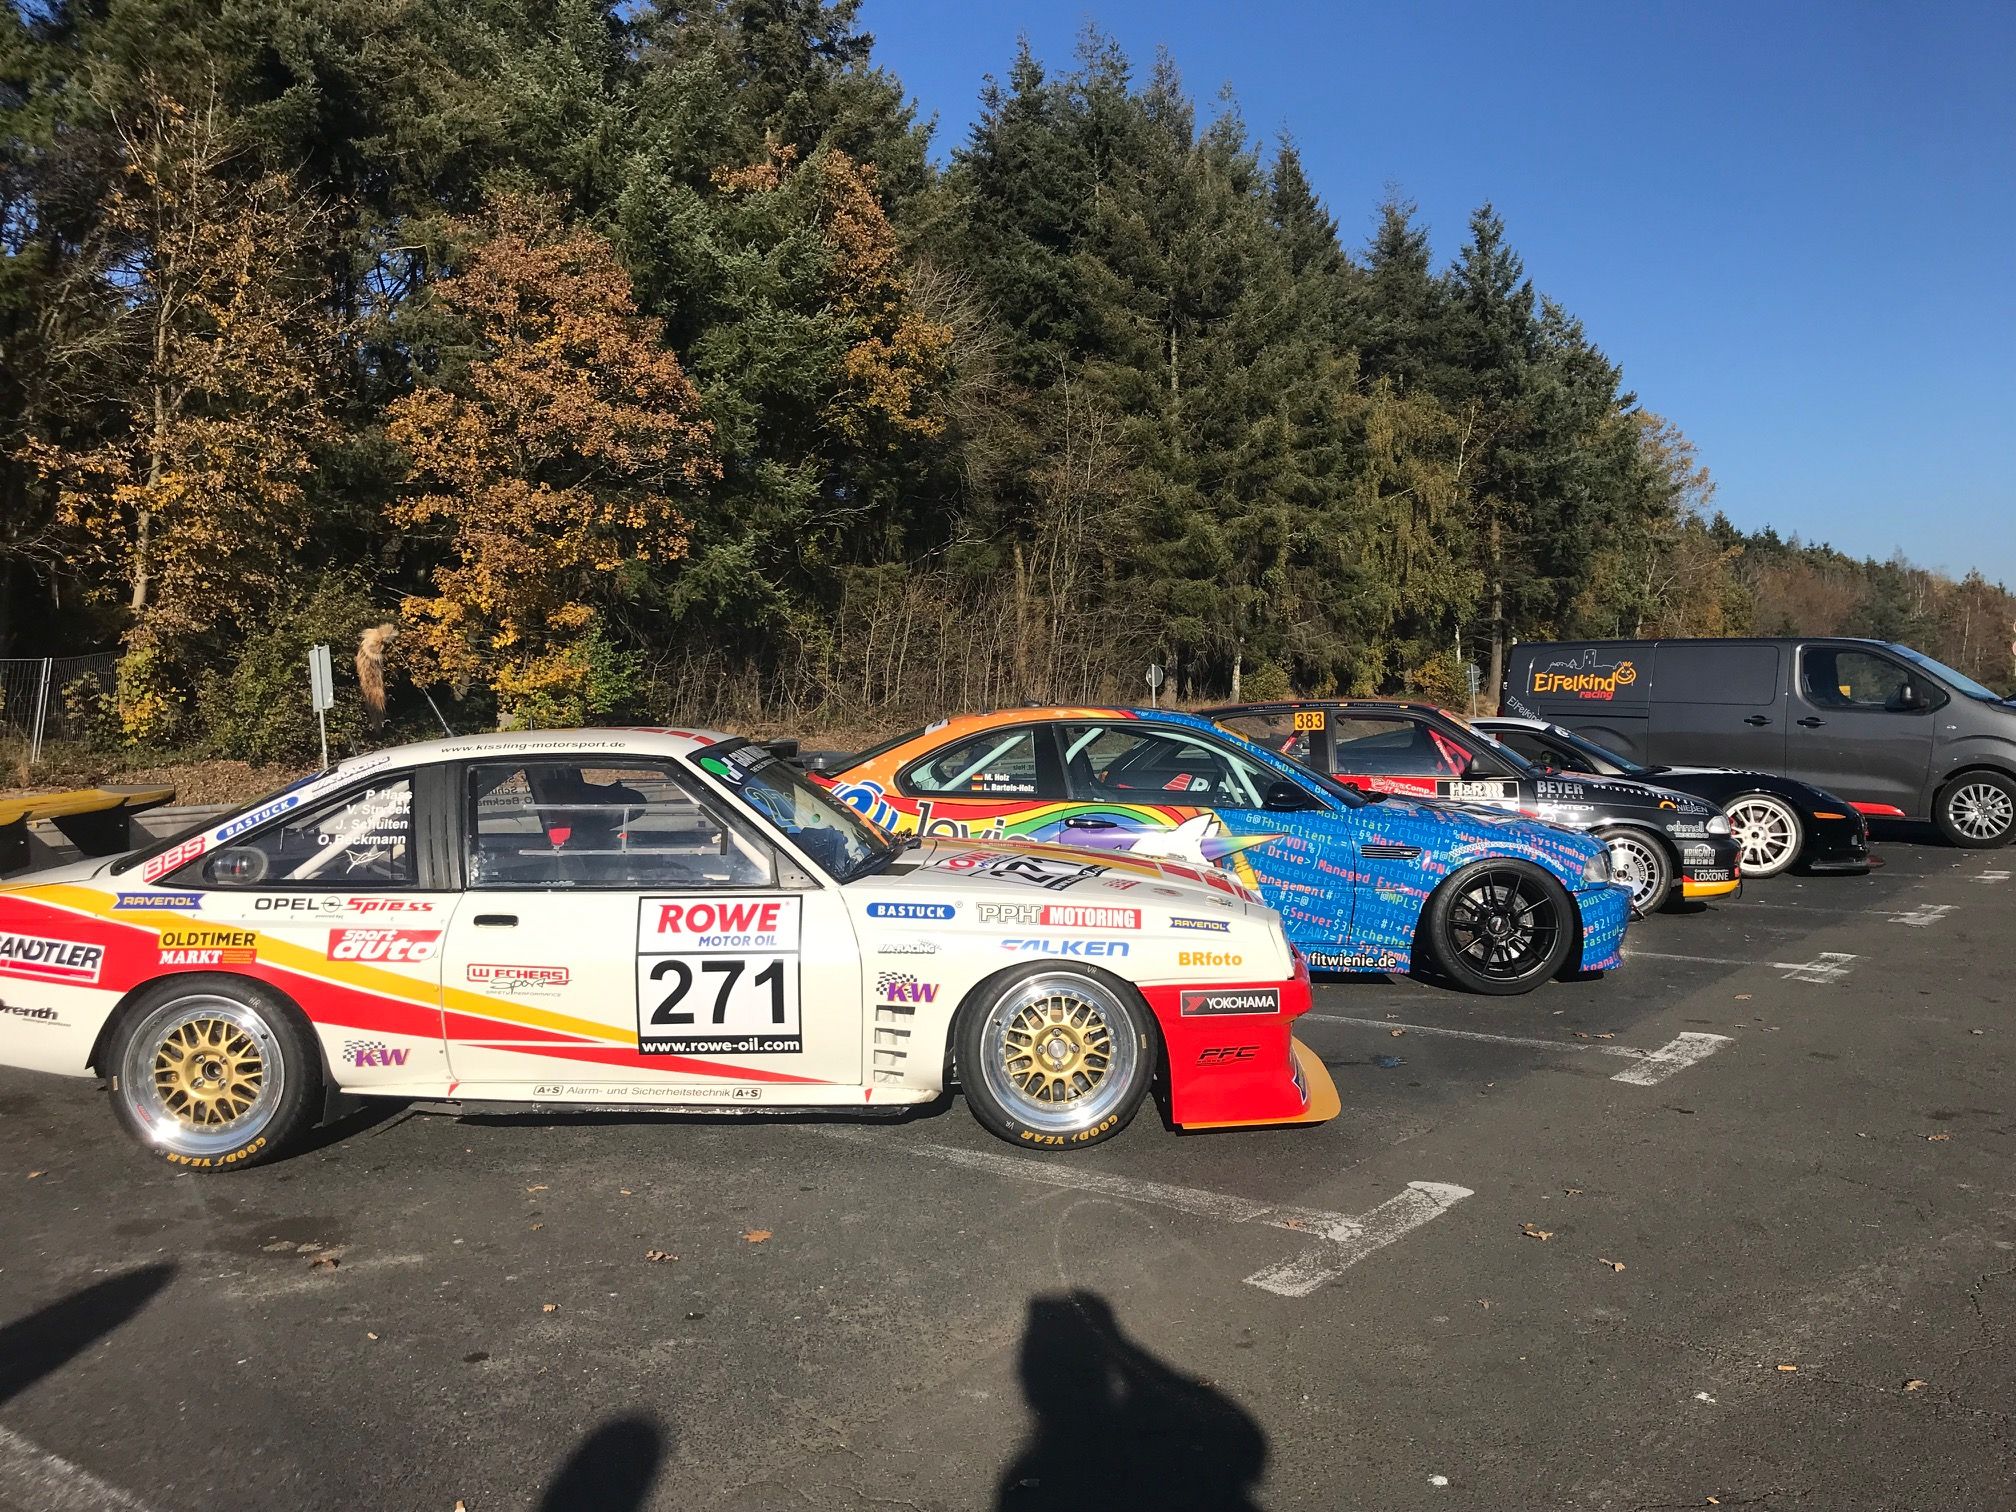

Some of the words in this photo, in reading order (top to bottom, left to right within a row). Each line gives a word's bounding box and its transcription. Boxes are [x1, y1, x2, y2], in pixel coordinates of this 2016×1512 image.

[1580, 690, 1613, 700] racing
[1296, 713, 1323, 729] 383
[441, 741, 626, 753] www.kissling-motorsport.de
[1537, 781, 1584, 794] BEYER
[347, 805, 357, 815] V.
[226, 800, 291, 836] BASTUCK
[336, 820, 346, 830] J.
[143, 836, 206, 883] BBS
[1694, 872, 1729, 881] LOXONE
[123, 896, 194, 906] RAVENOL
[255, 898, 320, 910] OPEL
[344, 897, 435, 914] Spiess
[657, 903, 781, 933] ROWE
[877, 905, 946, 917] BASTUCK
[976, 902, 1043, 925] PPH
[1049, 907, 1136, 928] MOTORING
[1173, 919, 1227, 930] RAVENOL
[162, 932, 256, 946] OLDTIMER
[342, 929, 399, 943] sport
[698, 936, 751, 947] MOTOR
[755, 935, 777, 946] OIL
[0, 936, 102, 969] ANDTLER
[333, 938, 437, 961] auto
[1000, 939, 1130, 956] FALKEN
[159, 950, 222, 964] MARKT
[1178, 951, 1243, 966] BRfoto
[649, 959, 785, 1025] 271
[887, 982, 939, 1002] KW
[1206, 995, 1276, 1010] YOKOHAMA
[641, 1037, 800, 1052] www.rowe-oil.com
[356, 1048, 411, 1067] KW
[1199, 1045, 1261, 1060] PFC
[536, 1086, 561, 1094] A+S
[566, 1086, 603, 1095] Alarm-
[607, 1087, 628, 1095] und
[632, 1087, 731, 1097] Sicherheitstechnik
[735, 1089, 759, 1097] A+S
